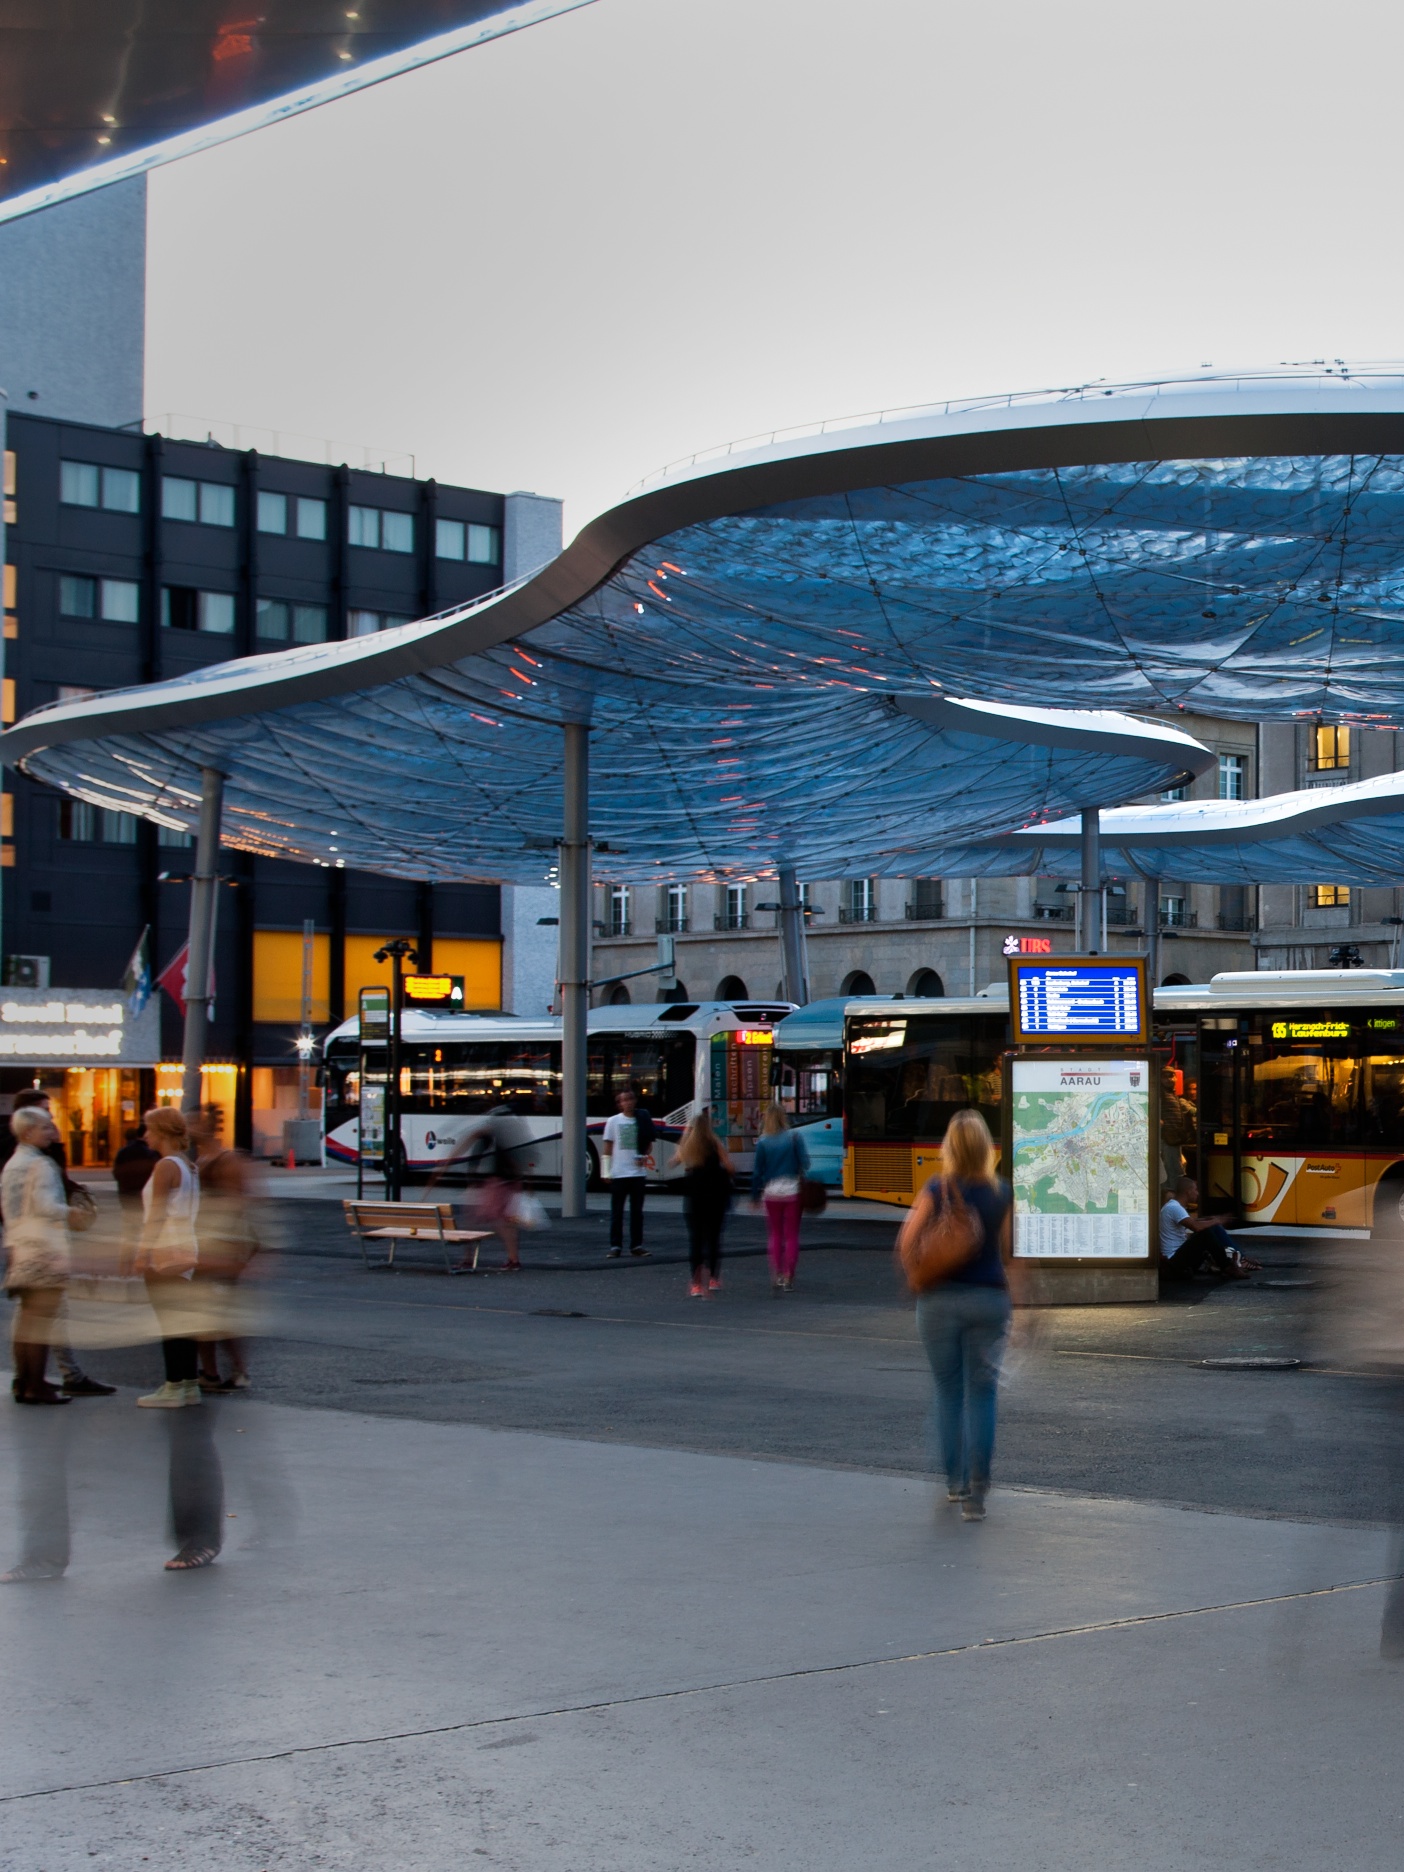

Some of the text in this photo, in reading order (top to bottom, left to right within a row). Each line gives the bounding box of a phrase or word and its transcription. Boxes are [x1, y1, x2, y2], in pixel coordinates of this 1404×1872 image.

[1020, 937, 1050, 953] UBS
[1272, 1022, 1287, 1038] 135
[1292, 1029, 1348, 1038] Laufenburg
[1060, 1077, 1101, 1086] AARAU
[1306, 1163, 1335, 1171] PostAuto
